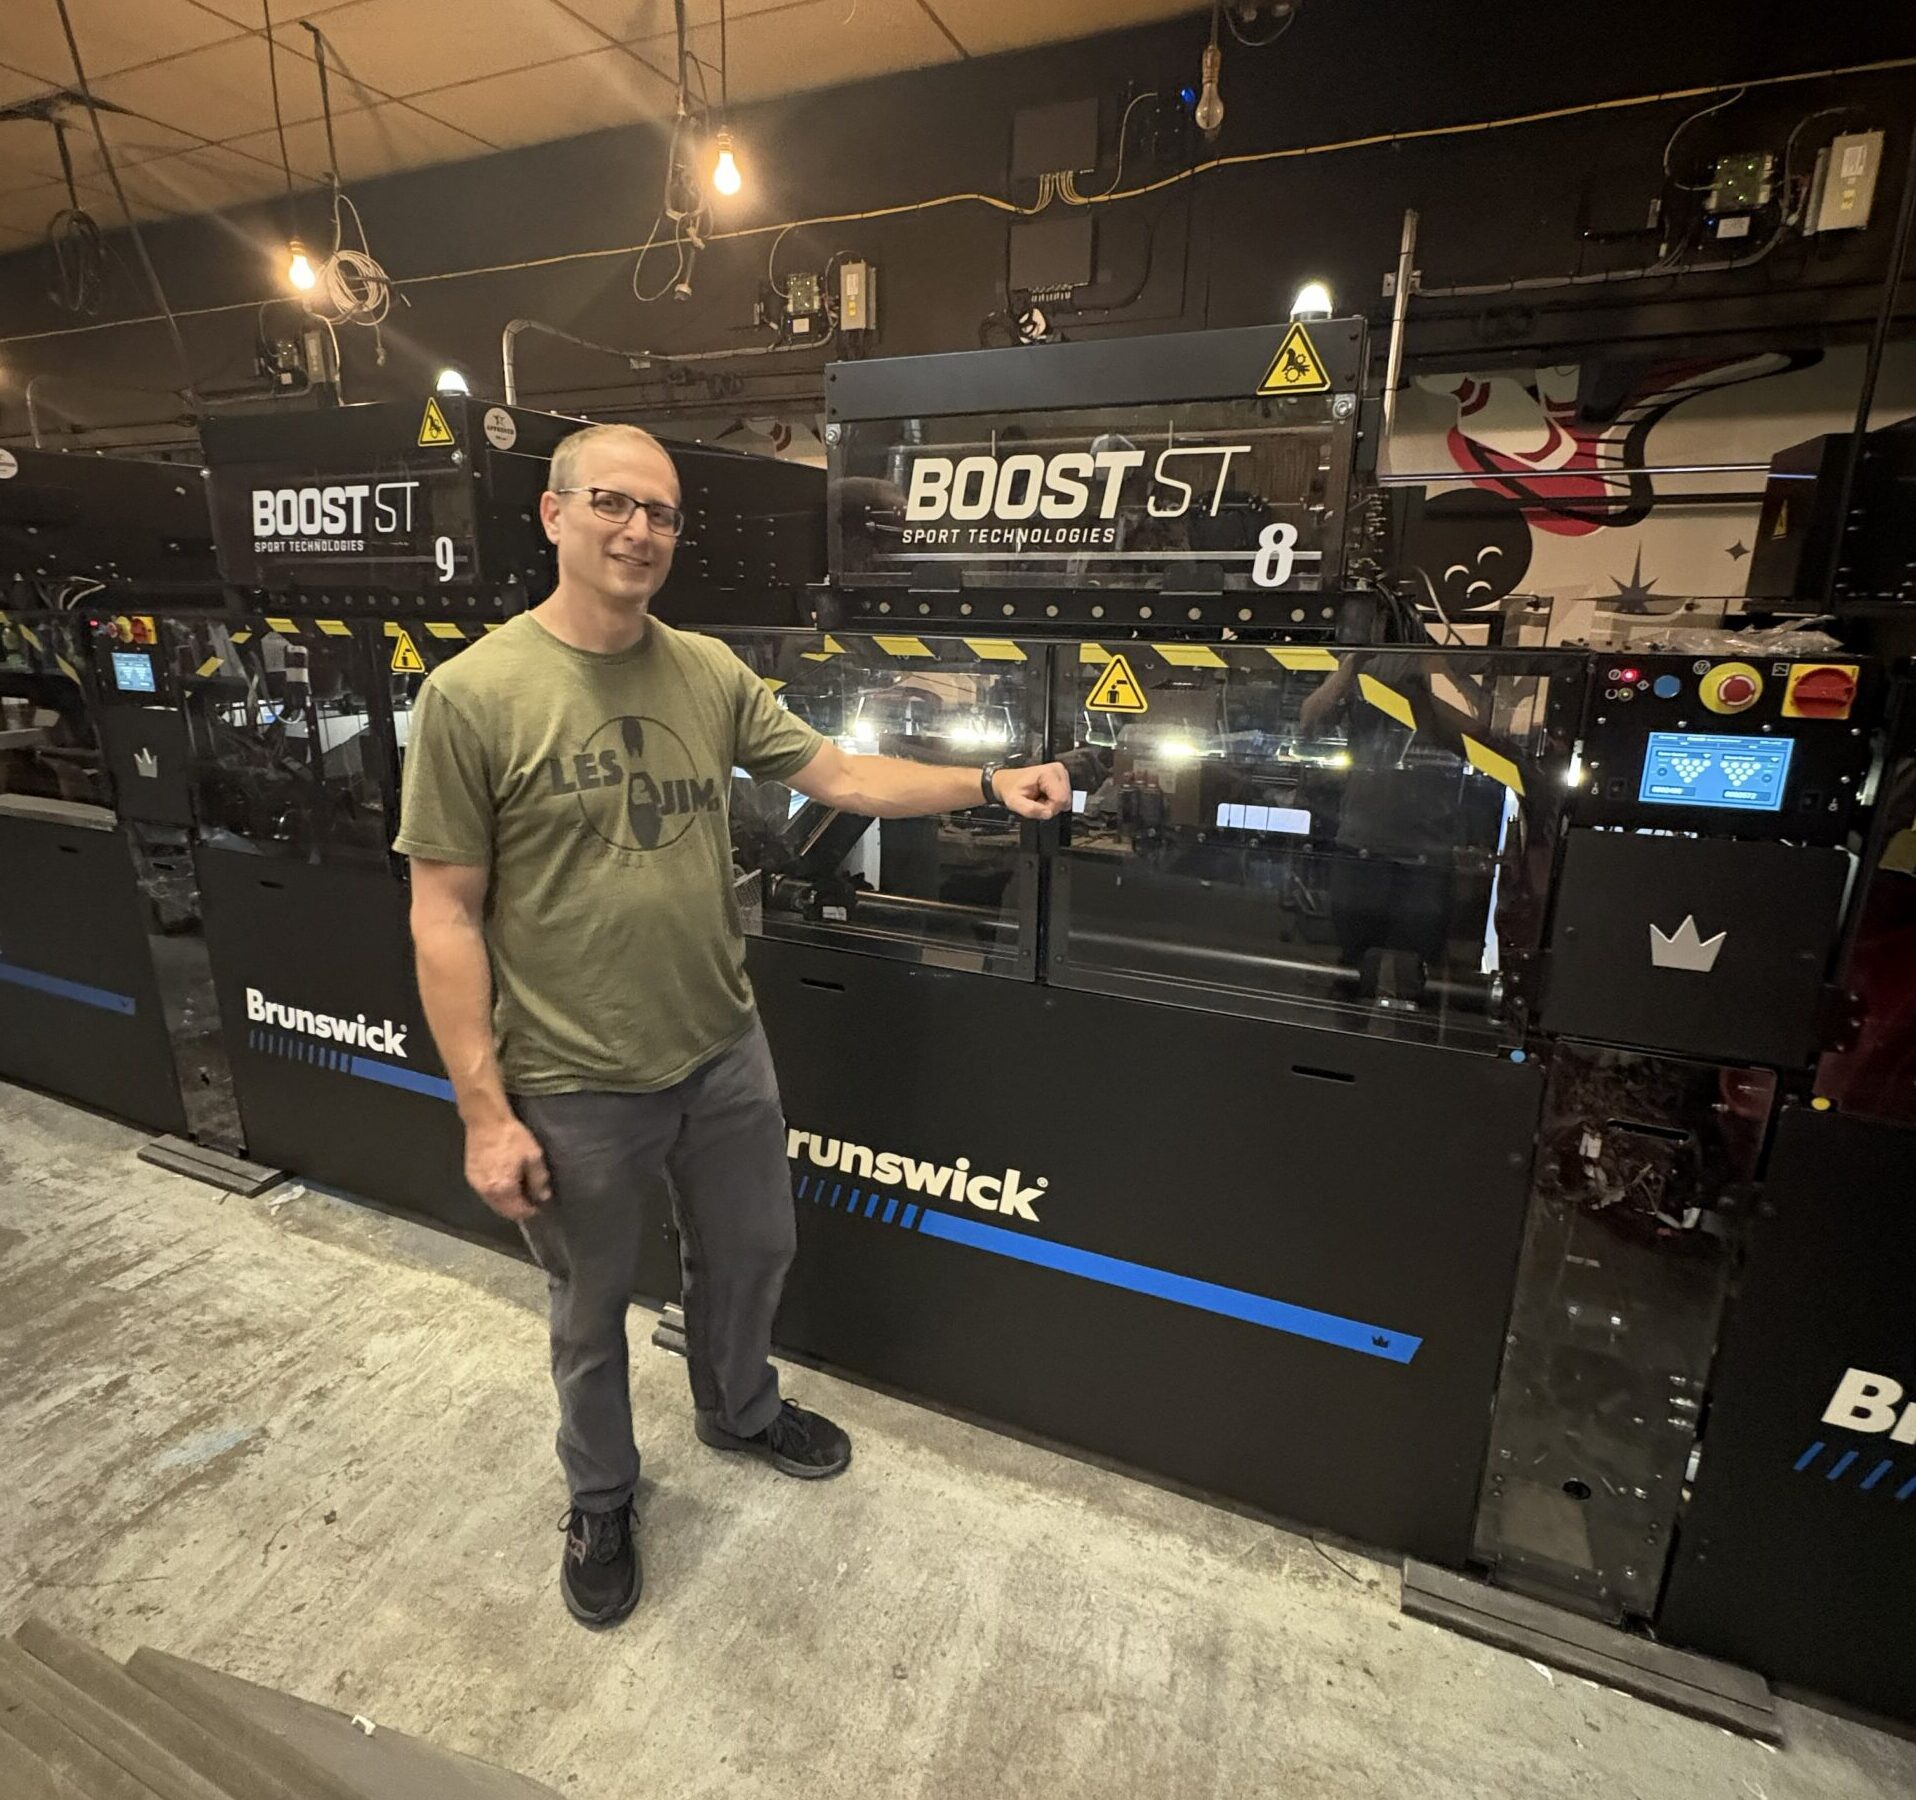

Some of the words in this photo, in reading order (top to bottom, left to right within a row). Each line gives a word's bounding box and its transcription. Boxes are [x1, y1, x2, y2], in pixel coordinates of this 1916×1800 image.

[252, 485, 369, 536] BOOST
[375, 481, 420, 532] ST
[905, 450, 1146, 521] BOOST
[1147, 445, 1252, 518] ST
[254, 541, 285, 553] SPORT
[289, 540, 364, 553] TECHNOLOGIES
[435, 536, 454, 582] 9
[902, 529, 960, 545] SPORT
[968, 527, 1117, 545] TECHNOLOGIES
[1252, 522, 1299, 588] 8
[550, 749, 624, 797] LES
[246, 987, 408, 1058] Brunswick
[786, 1131, 1046, 1223] runswick
